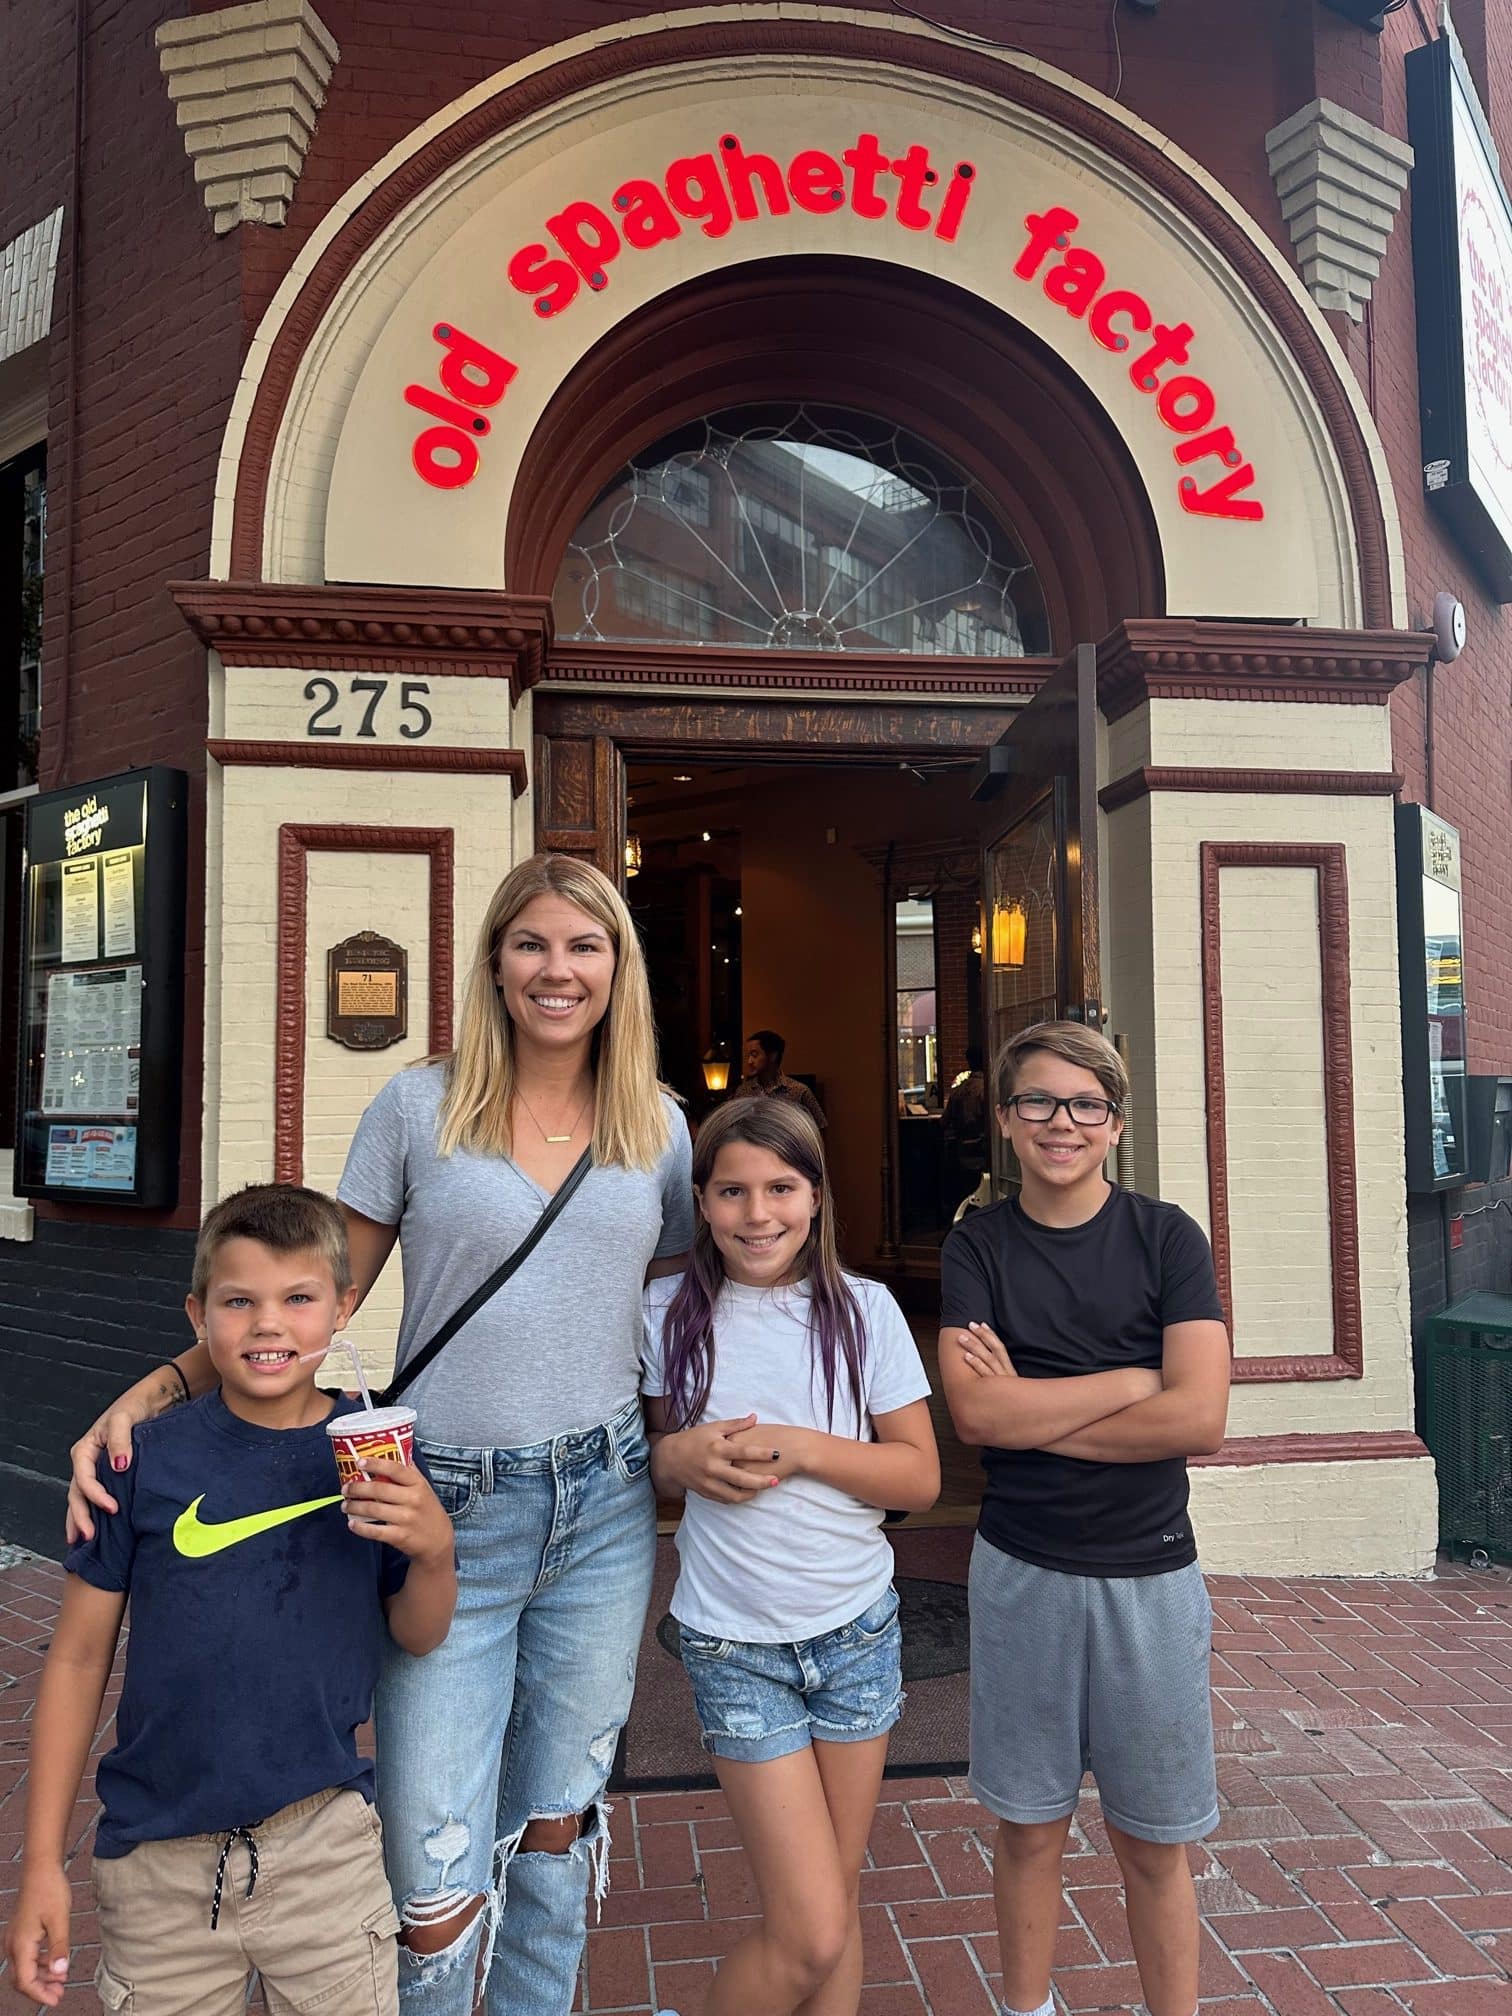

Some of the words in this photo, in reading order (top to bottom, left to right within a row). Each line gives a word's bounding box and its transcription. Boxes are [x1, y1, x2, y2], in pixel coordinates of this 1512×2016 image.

[403, 321, 519, 491] old
[507, 132, 977, 319] spaghetti
[1013, 206, 1265, 522] factory
[304, 677, 432, 739] 275
[362, 974, 372, 982] 71
